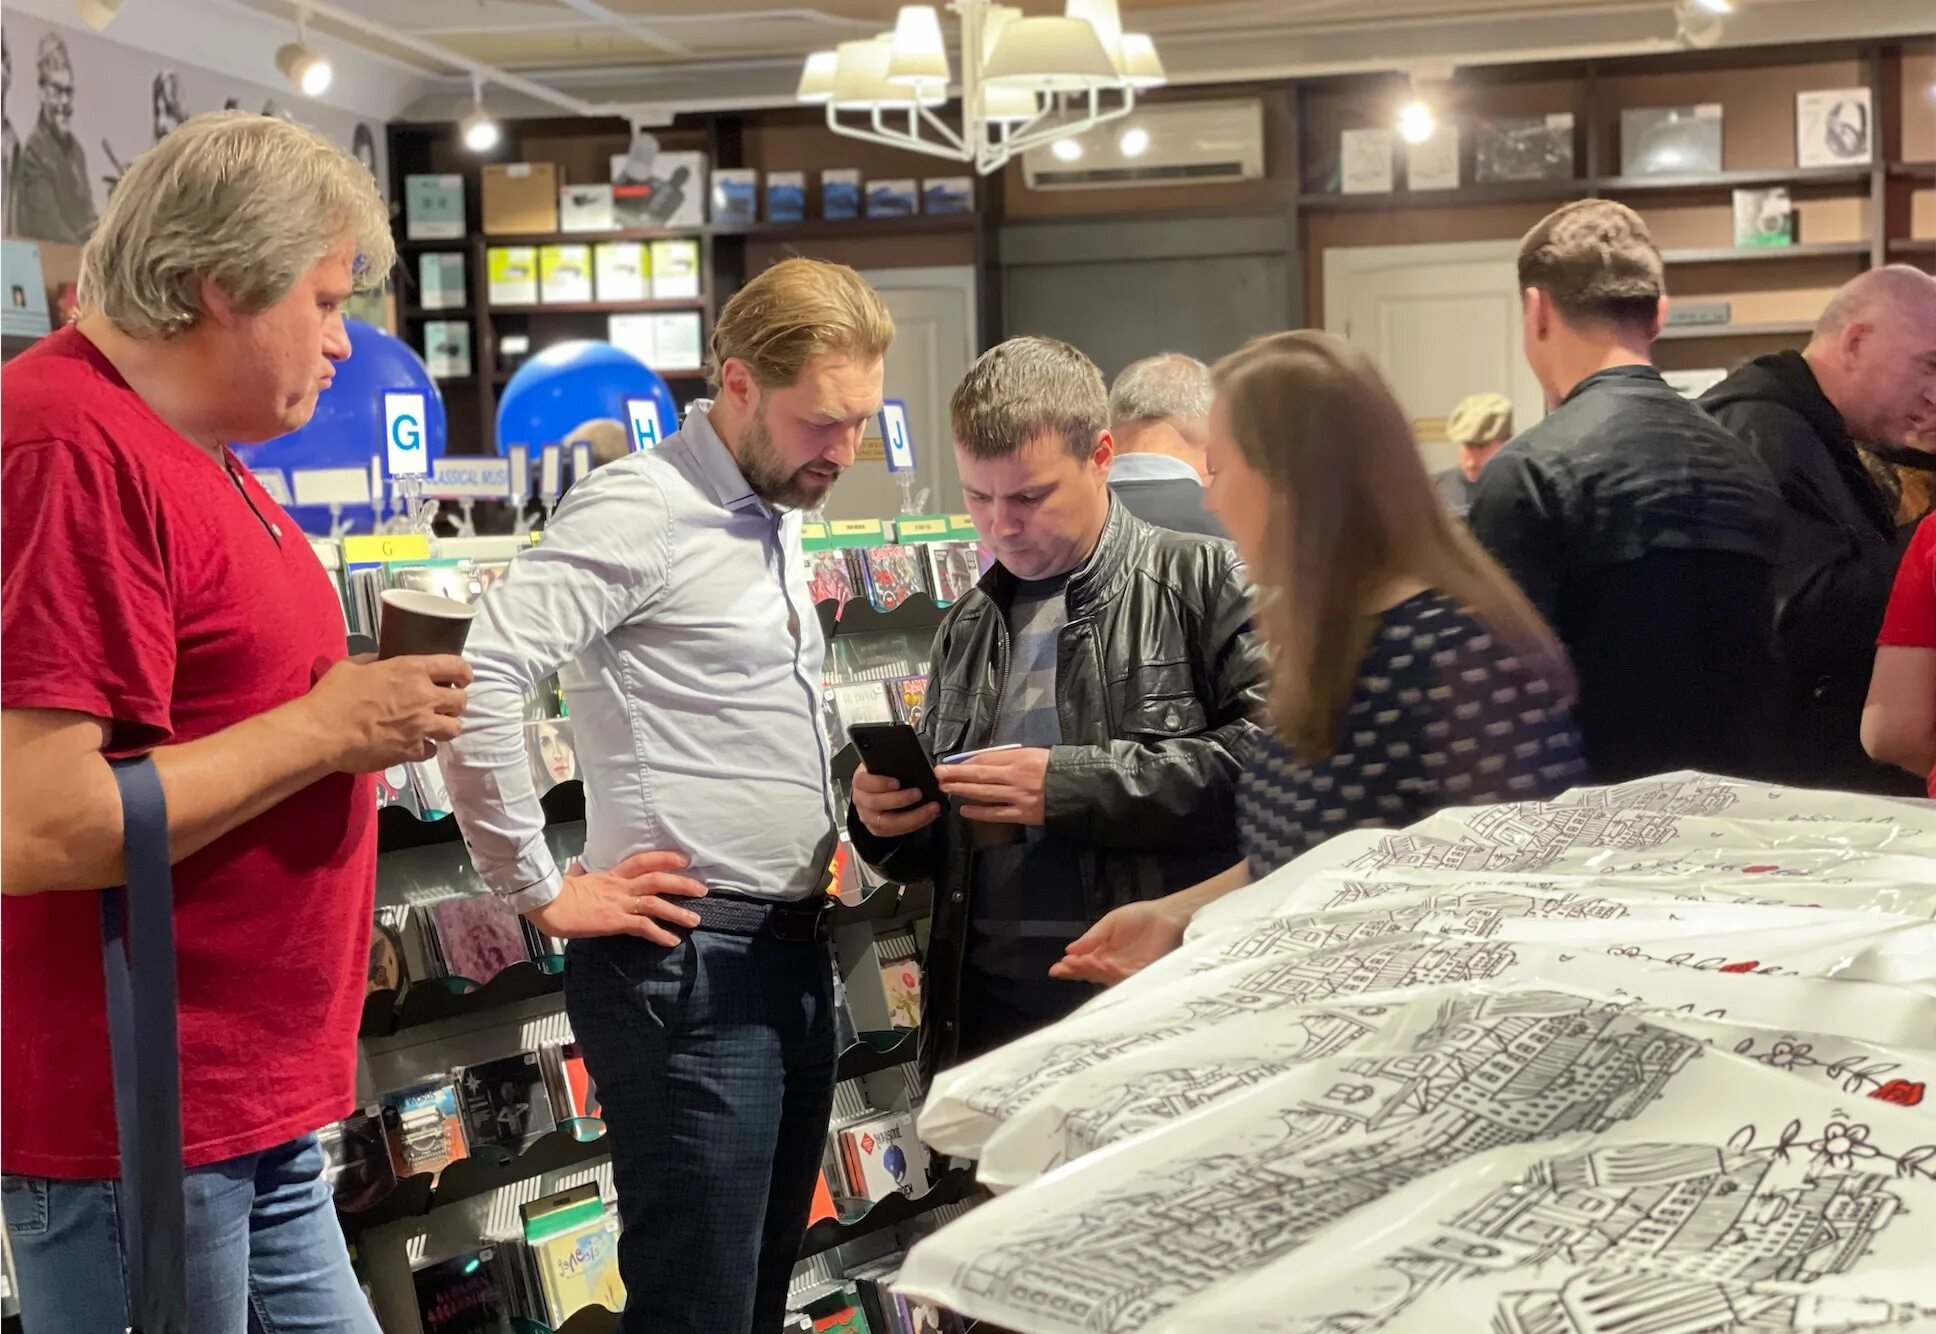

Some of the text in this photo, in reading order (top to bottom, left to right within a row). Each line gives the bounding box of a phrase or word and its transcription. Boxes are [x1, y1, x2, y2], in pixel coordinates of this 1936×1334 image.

[392, 414, 420, 450] G
[635, 418, 656, 449] H
[893, 420, 904, 449] J
[382, 541, 393, 556] G
